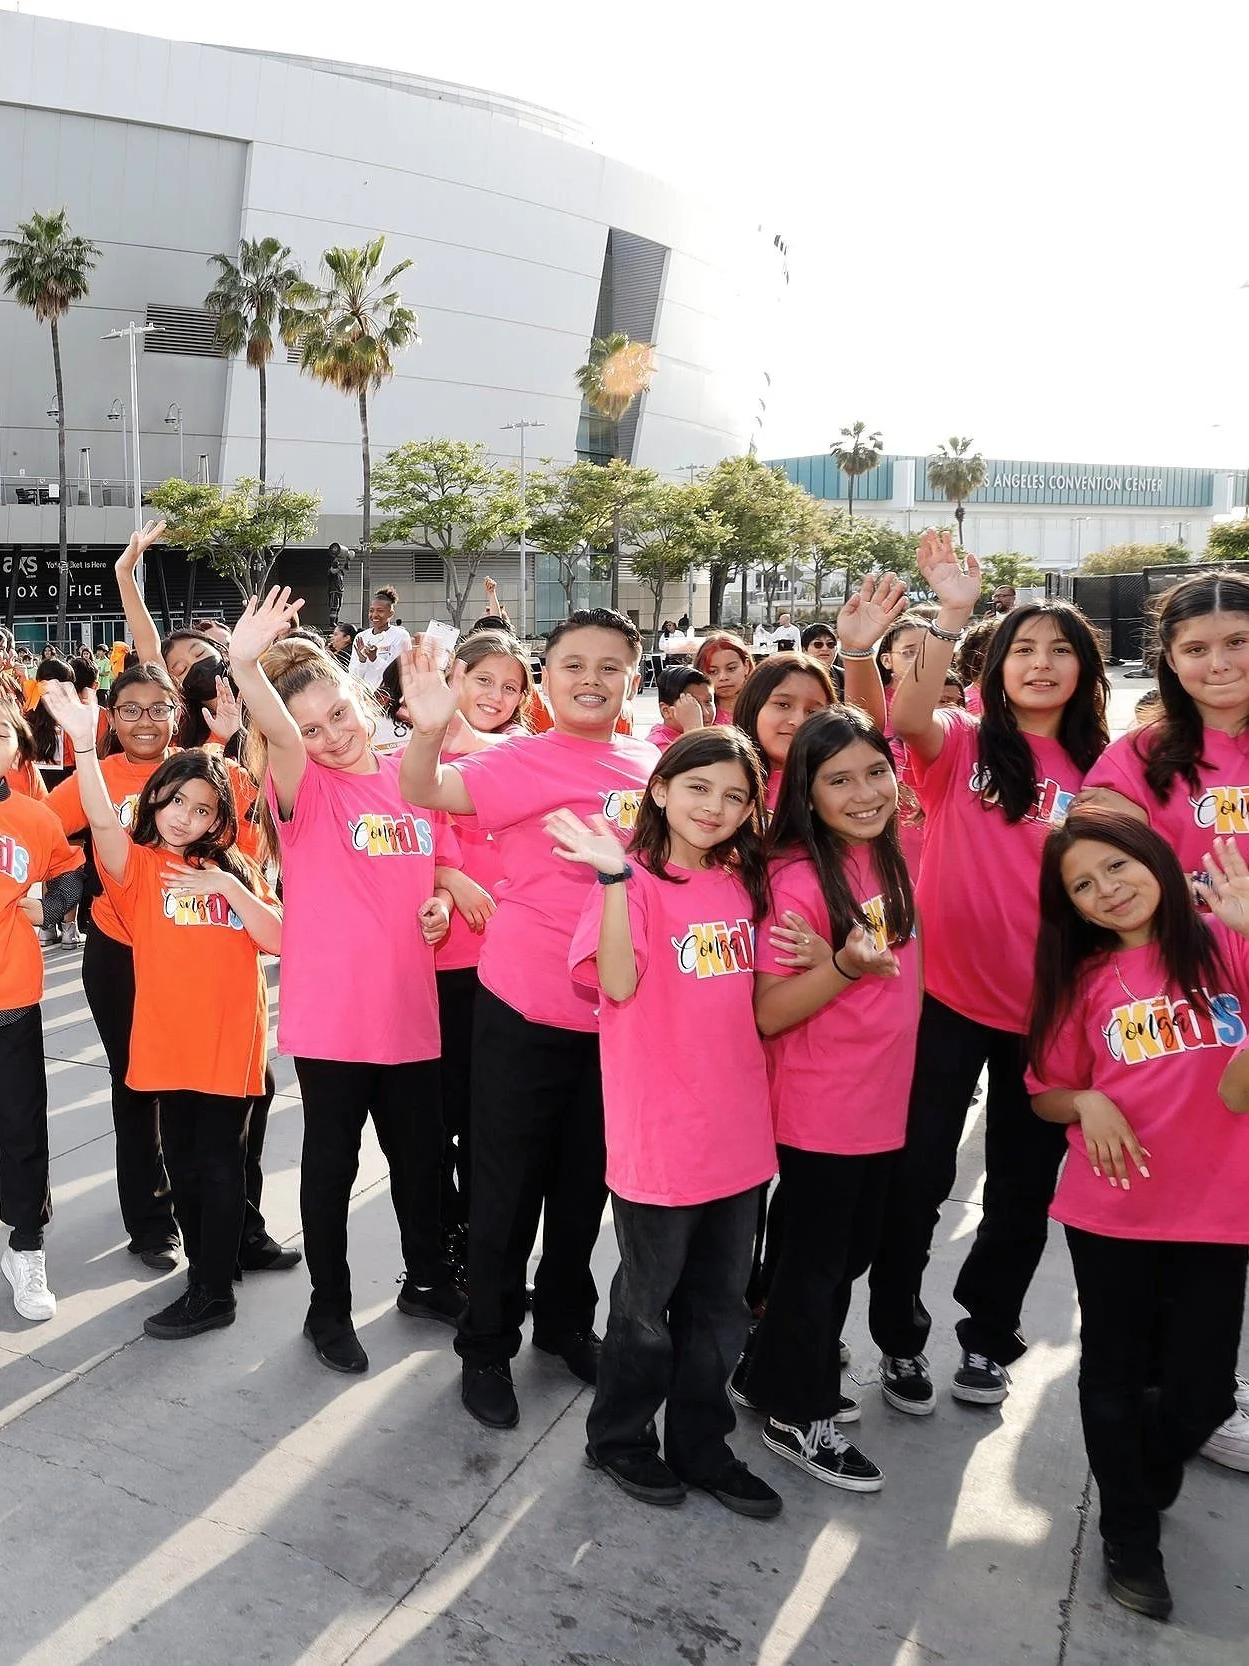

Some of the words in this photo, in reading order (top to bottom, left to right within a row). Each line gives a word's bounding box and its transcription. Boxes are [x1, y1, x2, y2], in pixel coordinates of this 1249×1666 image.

[993, 473, 1045, 489] ANGELES
[1048, 475, 1122, 492] CONVENTION
[1124, 477, 1163, 493] CENTER
[48, 584, 102, 597] OFICE
[359, 813, 433, 857] Kids
[688, 919, 756, 979] Kid
[1111, 988, 1246, 1064] Kids
